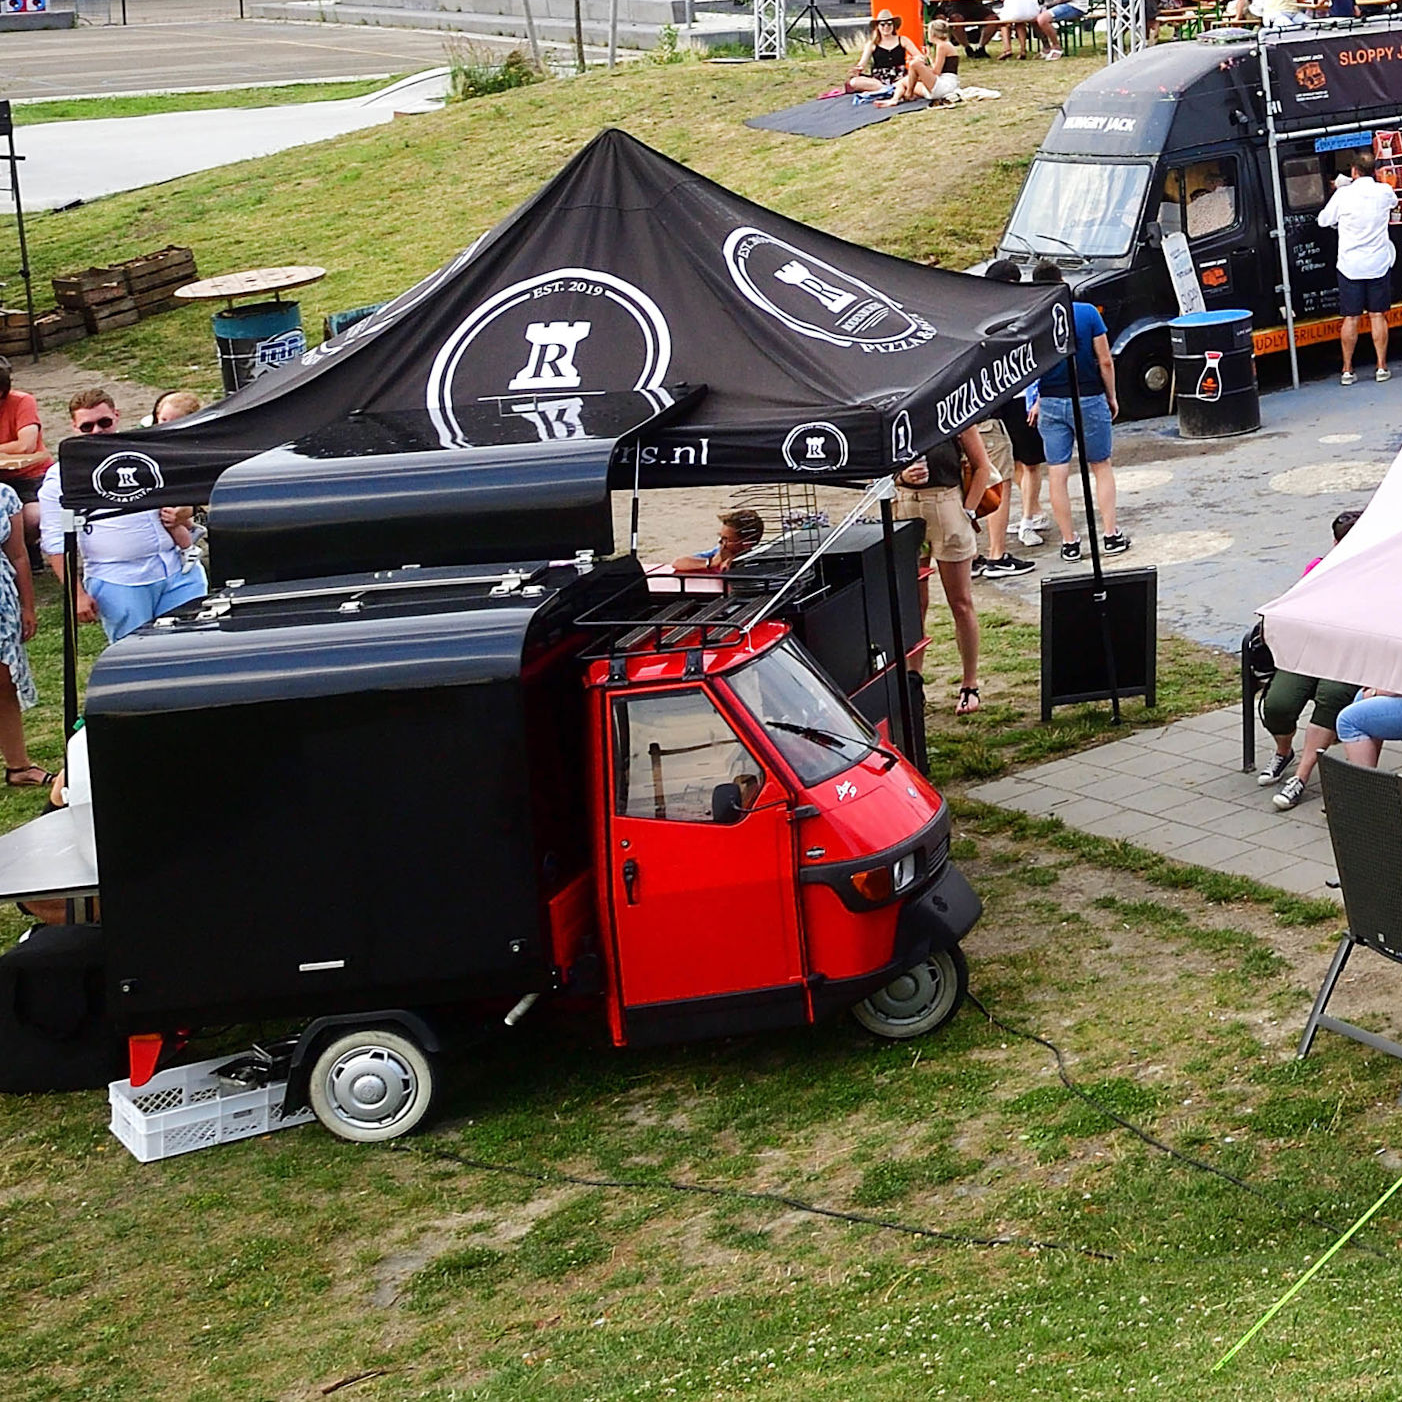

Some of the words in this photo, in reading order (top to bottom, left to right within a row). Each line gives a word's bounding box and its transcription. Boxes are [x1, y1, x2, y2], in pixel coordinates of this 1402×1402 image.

[1339, 46, 1395, 67] SLOPPY
[1062, 116, 1106, 131] HUNGRY
[1104, 117, 1136, 133] JACK
[532, 281, 564, 299] EST.
[569, 280, 604, 297] 2019
[1256, 333, 1287, 351] UDLY
[936, 377, 986, 434] PIZZA
[980, 367, 999, 402] &
[993, 341, 1038, 394] PASTA
